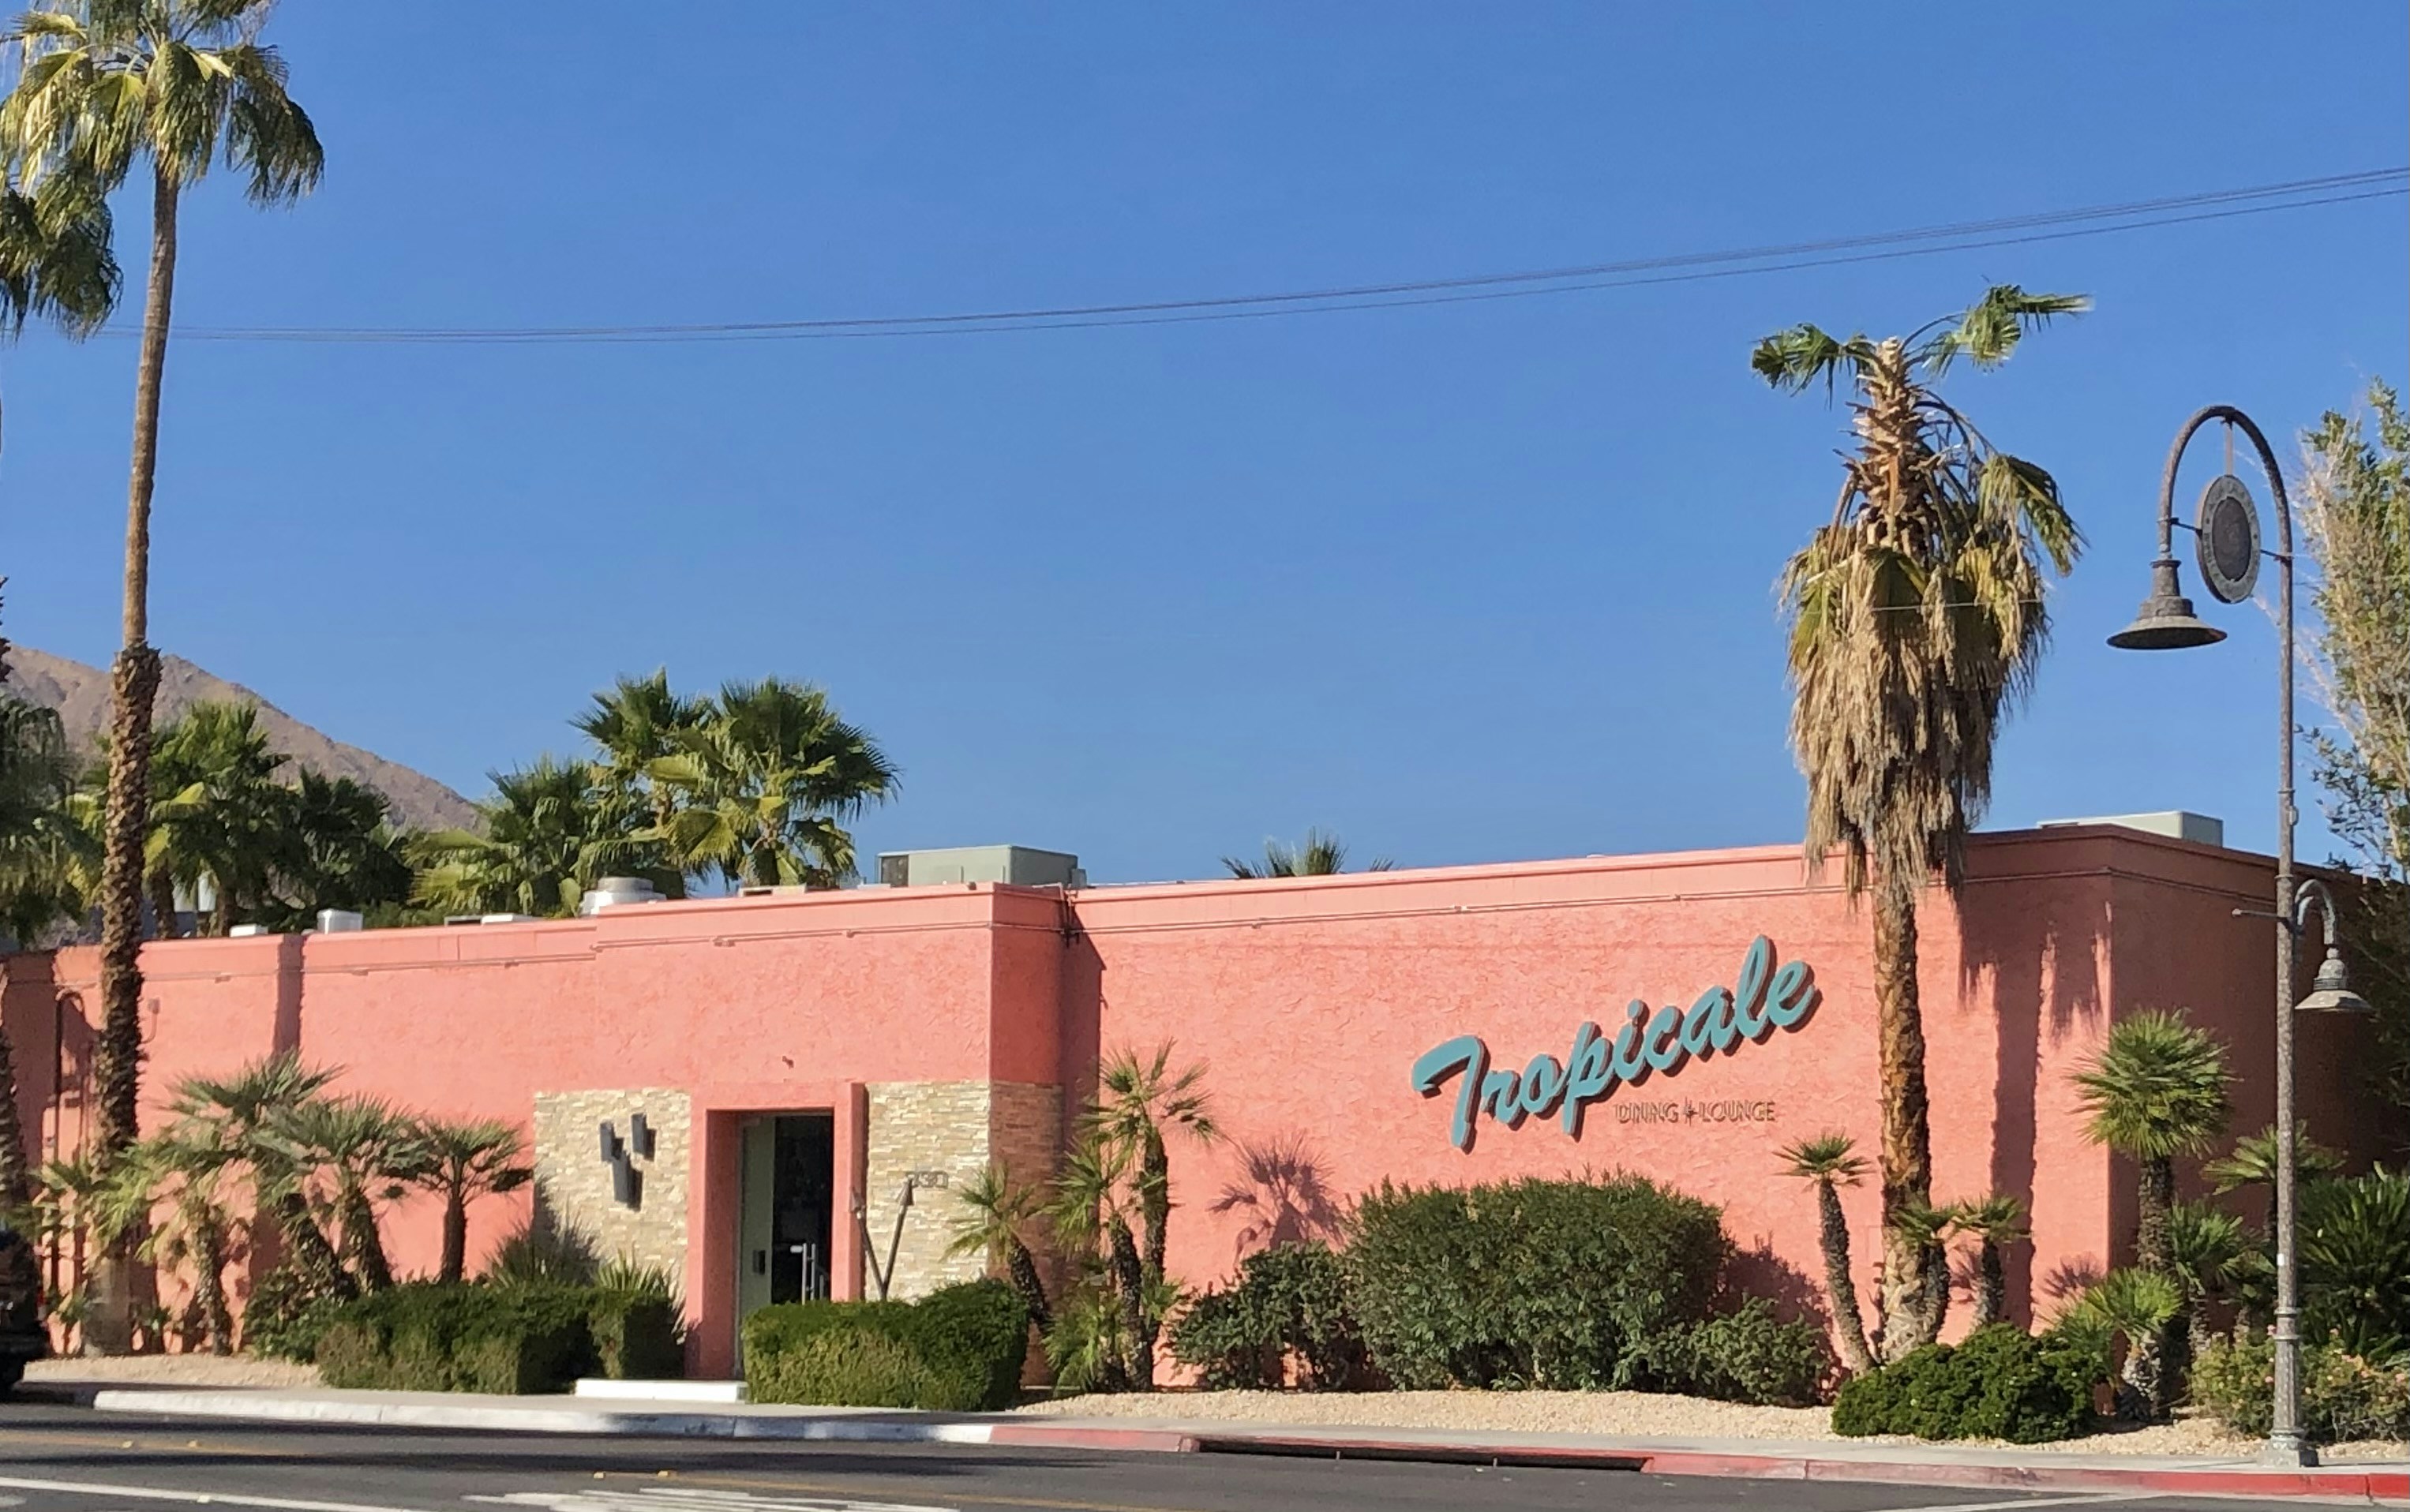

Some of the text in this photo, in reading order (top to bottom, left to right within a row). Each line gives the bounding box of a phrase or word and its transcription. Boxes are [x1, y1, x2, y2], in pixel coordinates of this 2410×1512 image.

[1412, 934, 1822, 1153] Tropicale
[1615, 1100, 1775, 1122] DINING LOUNGE
